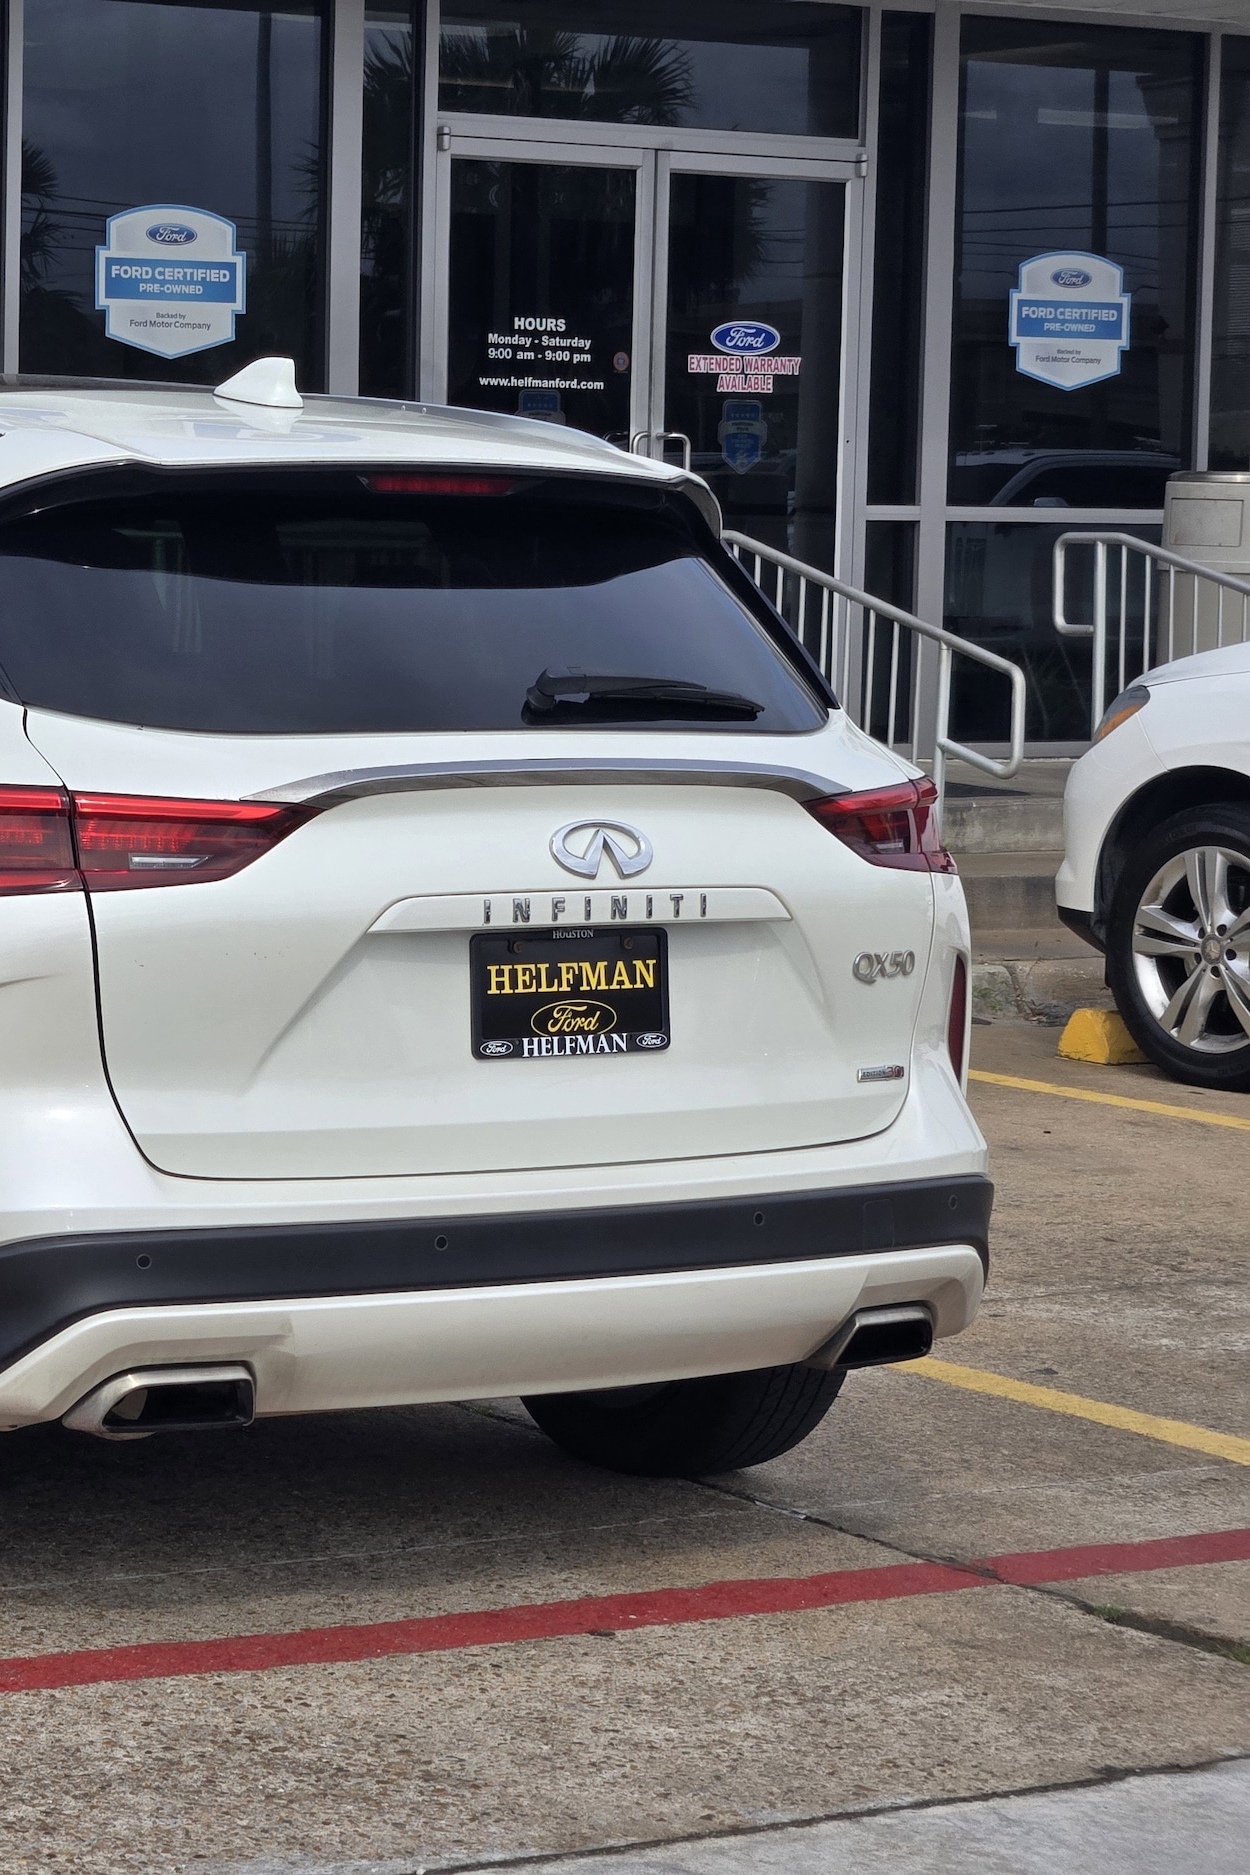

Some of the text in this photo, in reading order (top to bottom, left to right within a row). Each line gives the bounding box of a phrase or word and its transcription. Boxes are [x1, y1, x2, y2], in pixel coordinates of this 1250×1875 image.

[155, 226, 188, 242] Ford
[111, 265, 230, 282] FORD CERTIFIED
[139, 283, 203, 295] PRE-OWNED
[1022, 306, 1118, 321] FORD CERTIFIED
[130, 320, 211, 330] Ford Motor Company
[514, 317, 566, 332] HOURS
[1044, 322, 1096, 333] PRE-OWNED
[488, 333, 532, 347] Monday
[541, 335, 591, 350] Saturday
[725, 327, 766, 348] Ford
[488, 348, 512, 359] 9:00
[516, 351, 535, 360] am
[544, 350, 570, 361] 9:00
[573, 353, 591, 364] pm
[1035, 355, 1050, 363] Ford
[1071, 356, 1101, 365] Company
[688, 355, 801, 375] EXTENDED WARRANTY
[479, 376, 604, 390] www.helfmanford.com
[717, 374, 773, 393] AVAILABLE
[483, 893, 707, 924] INFINITI
[853, 950, 916, 985] QX50
[486, 959, 657, 995] HELFMAN
[547, 1005, 601, 1033] Ford
[486, 1033, 663, 1058] Ford HELFMAN Ford
